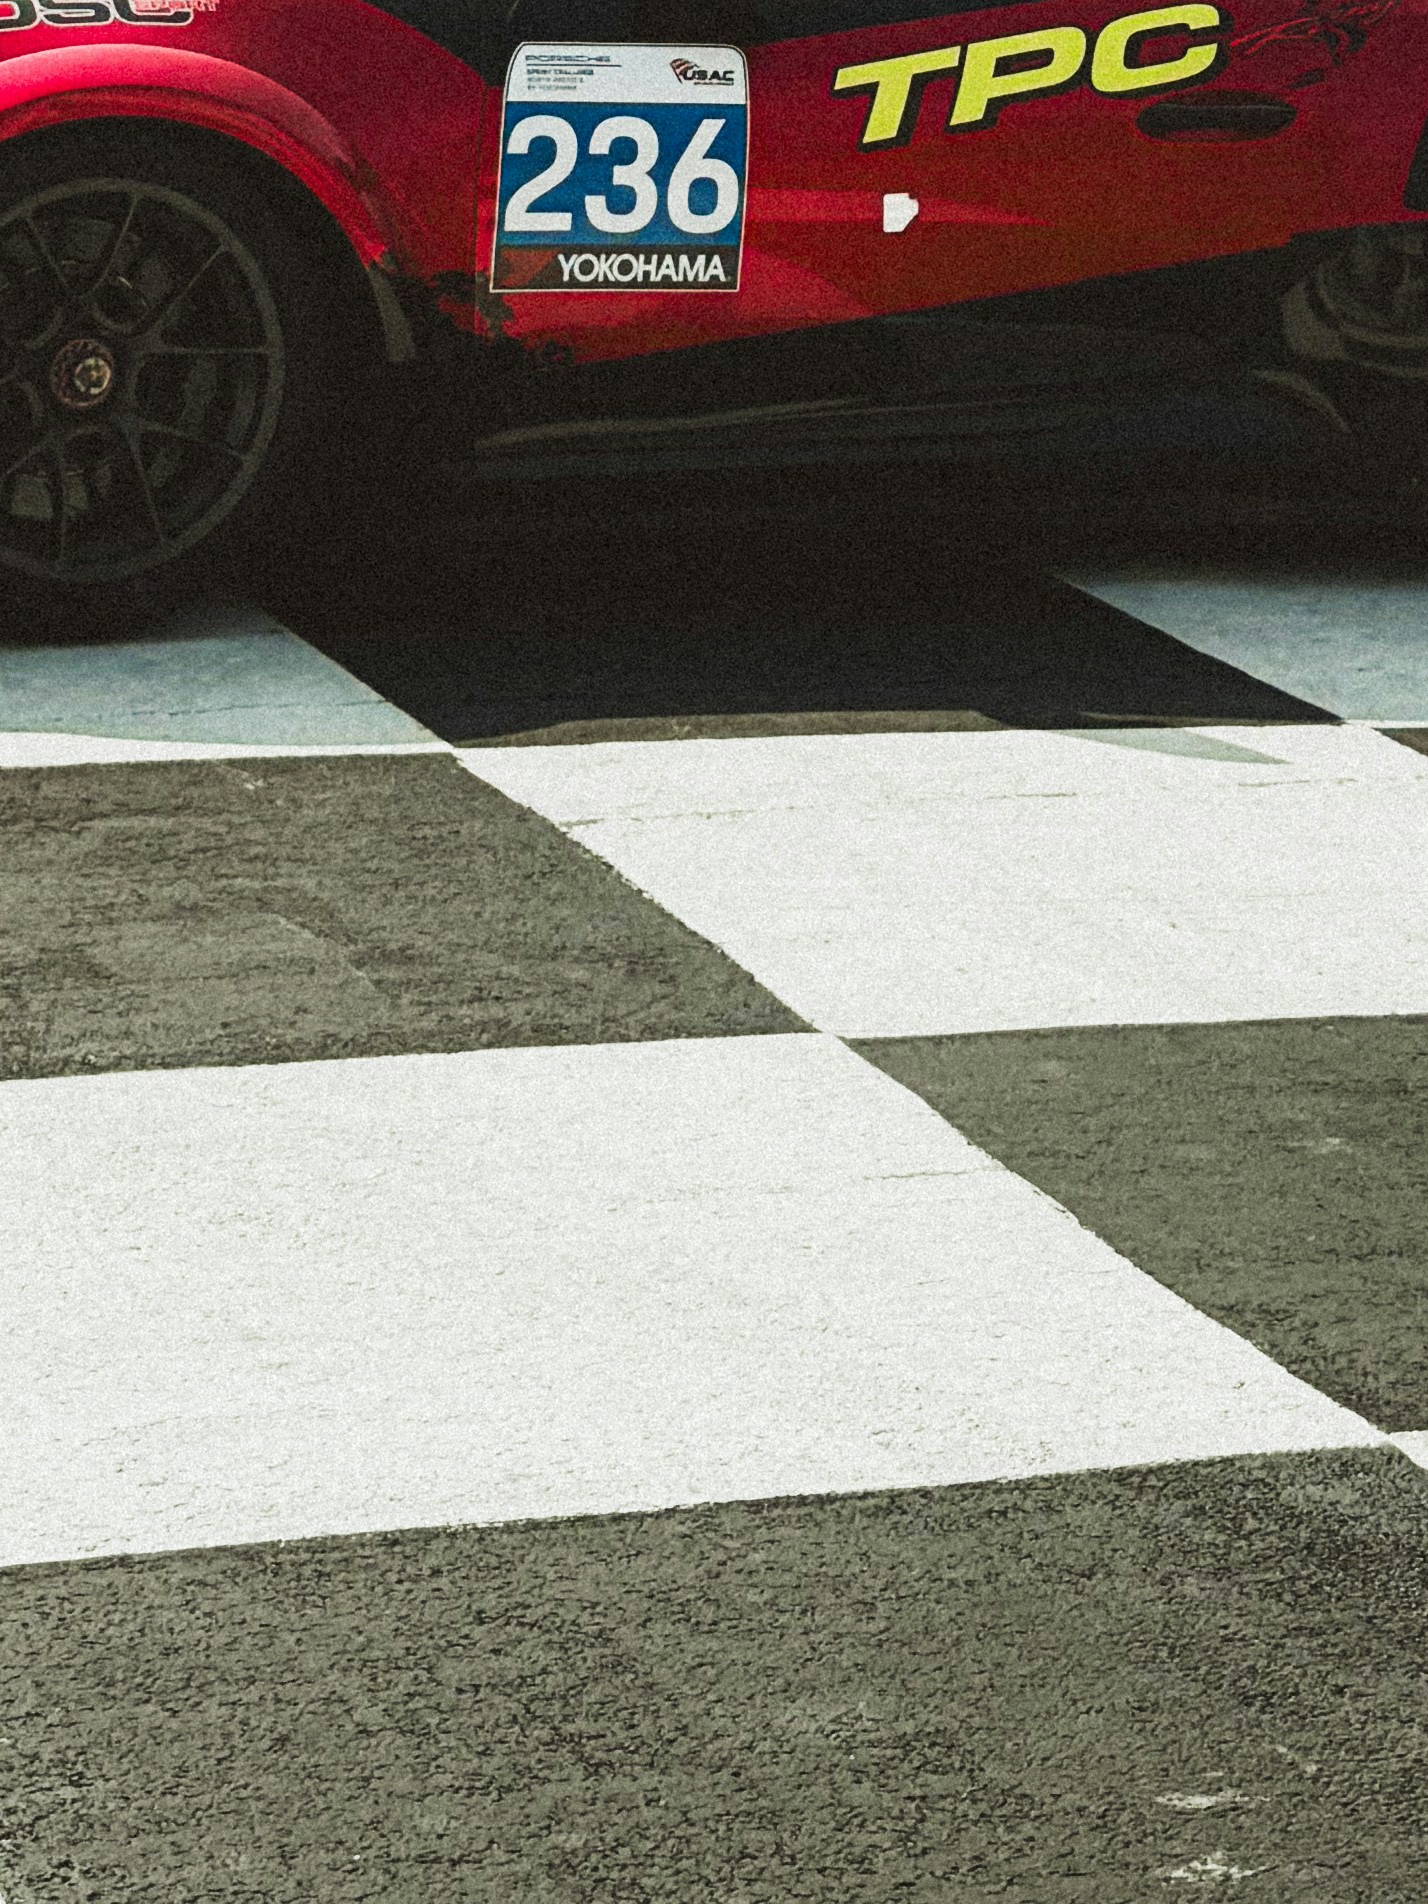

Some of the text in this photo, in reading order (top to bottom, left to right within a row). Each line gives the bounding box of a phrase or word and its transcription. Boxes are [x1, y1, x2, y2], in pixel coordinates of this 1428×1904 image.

[524, 54, 611, 63] PORSCHE
[682, 69, 735, 82] USAC
[833, 3, 1222, 147] TPC
[503, 114, 740, 235] 236
[557, 253, 727, 283] YOKOHAMA
